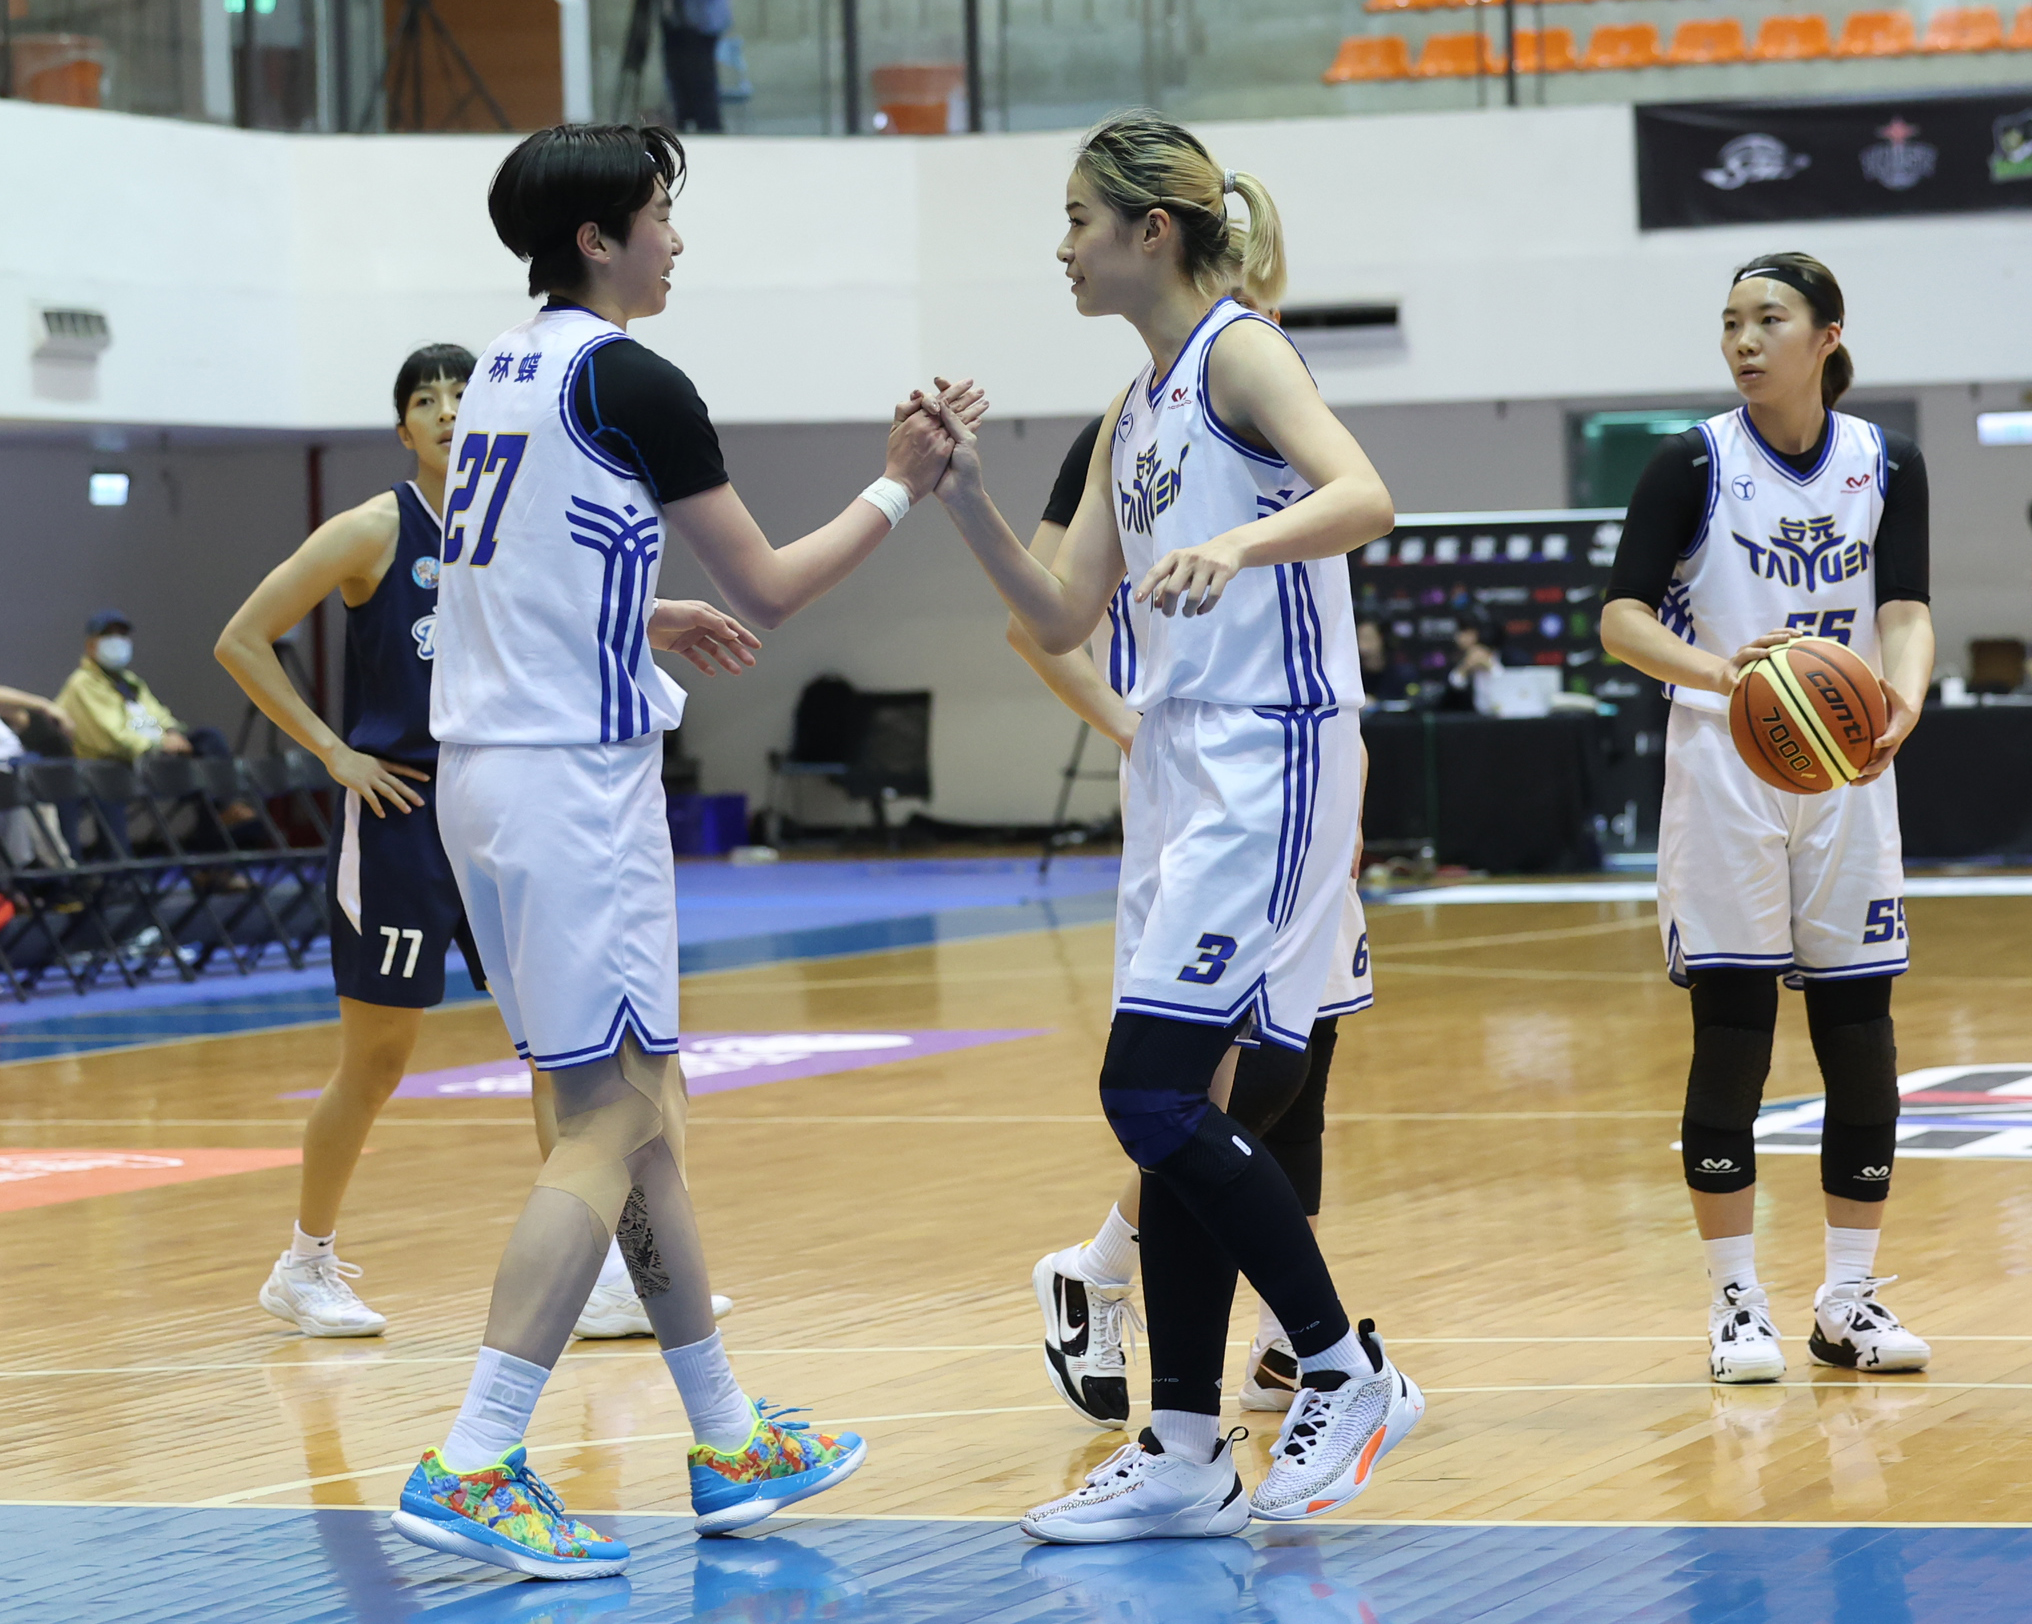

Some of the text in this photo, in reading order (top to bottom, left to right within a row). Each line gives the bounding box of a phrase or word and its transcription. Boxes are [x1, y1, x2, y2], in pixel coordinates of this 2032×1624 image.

[488, 352, 542, 383] 林蝶
[443, 430, 530, 568] 27
[1779, 514, 1836, 543] 台元
[1805, 670, 1868, 744] conti
[1762, 706, 1811, 771] 7000
[1862, 896, 1904, 946] 5
[380, 926, 423, 978] 77
[1176, 932, 1238, 985] 3
